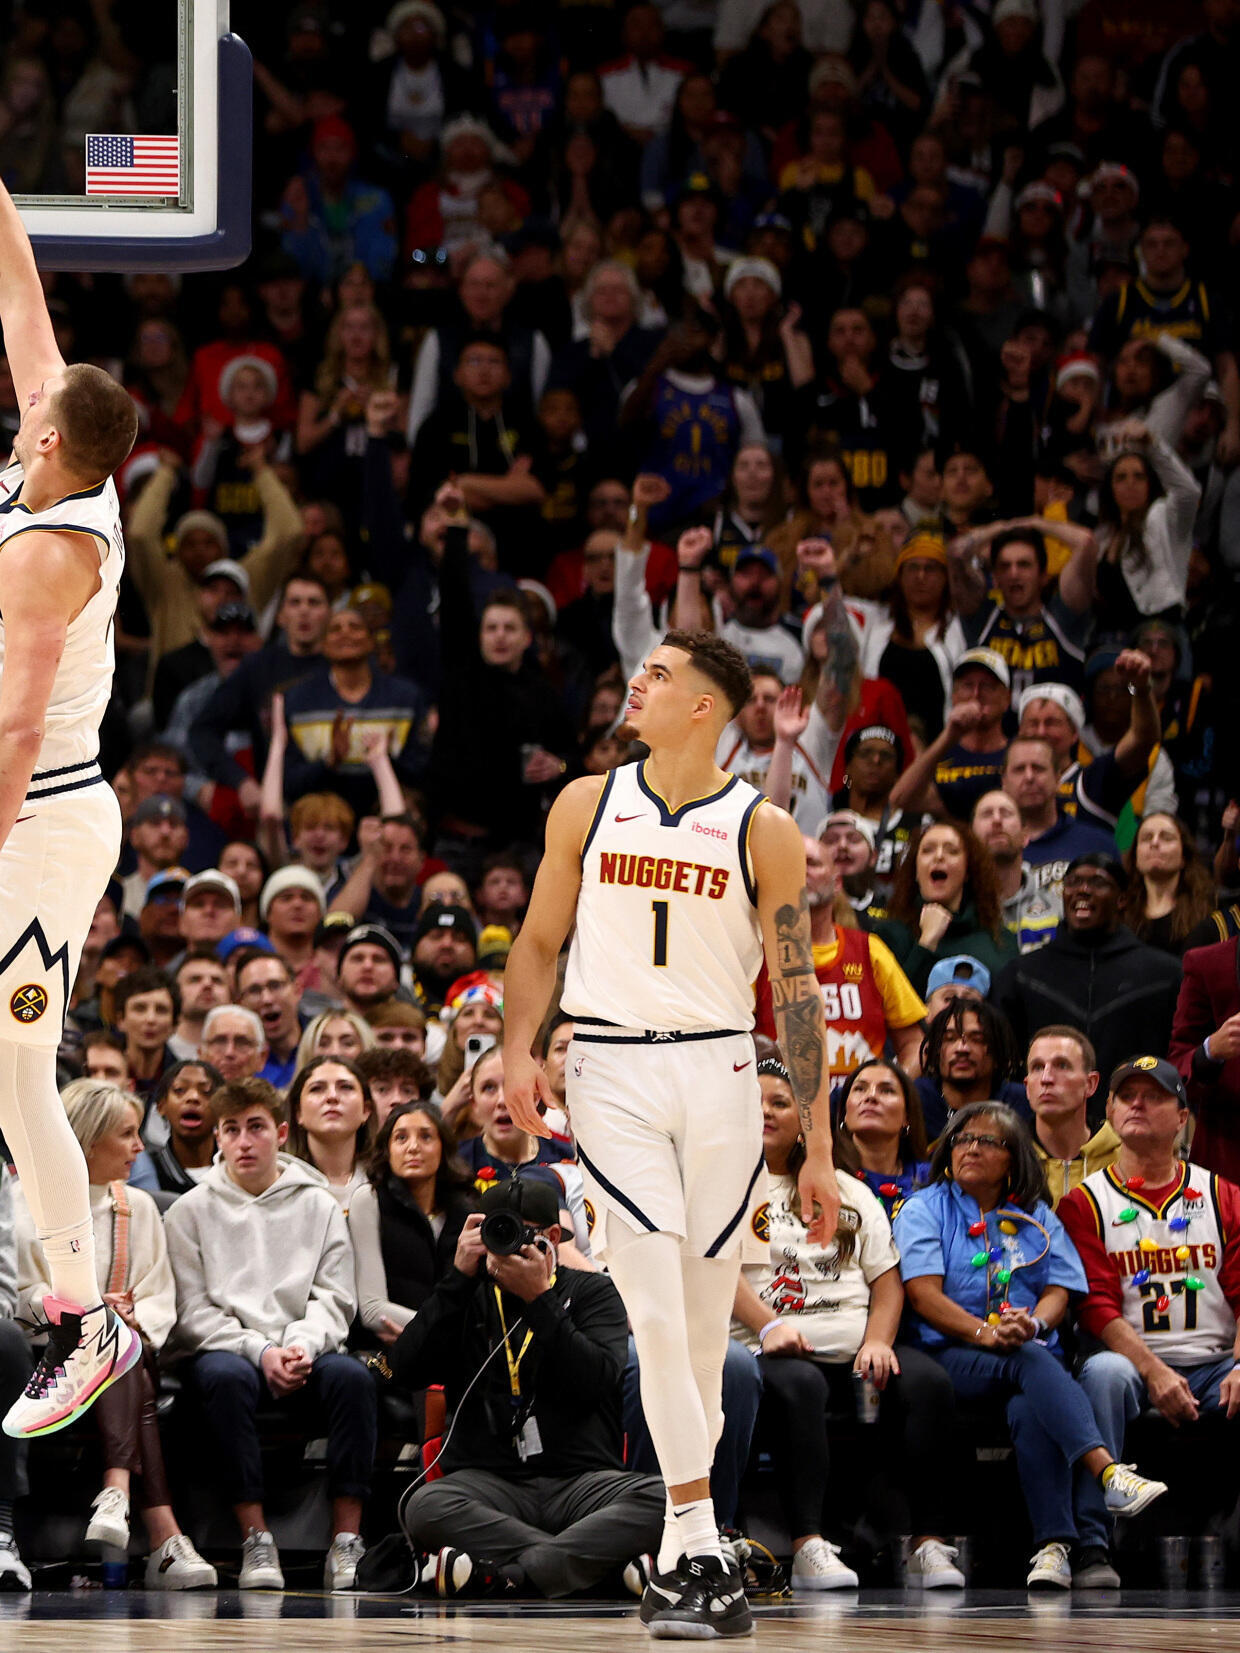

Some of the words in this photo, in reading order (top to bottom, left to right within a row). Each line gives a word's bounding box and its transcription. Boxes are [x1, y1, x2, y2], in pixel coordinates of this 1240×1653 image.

[691, 821, 728, 841] ibotta
[599, 852, 730, 900] NUGGETS
[651, 900, 669, 968] 1
[1139, 1280, 1198, 1333] 27
